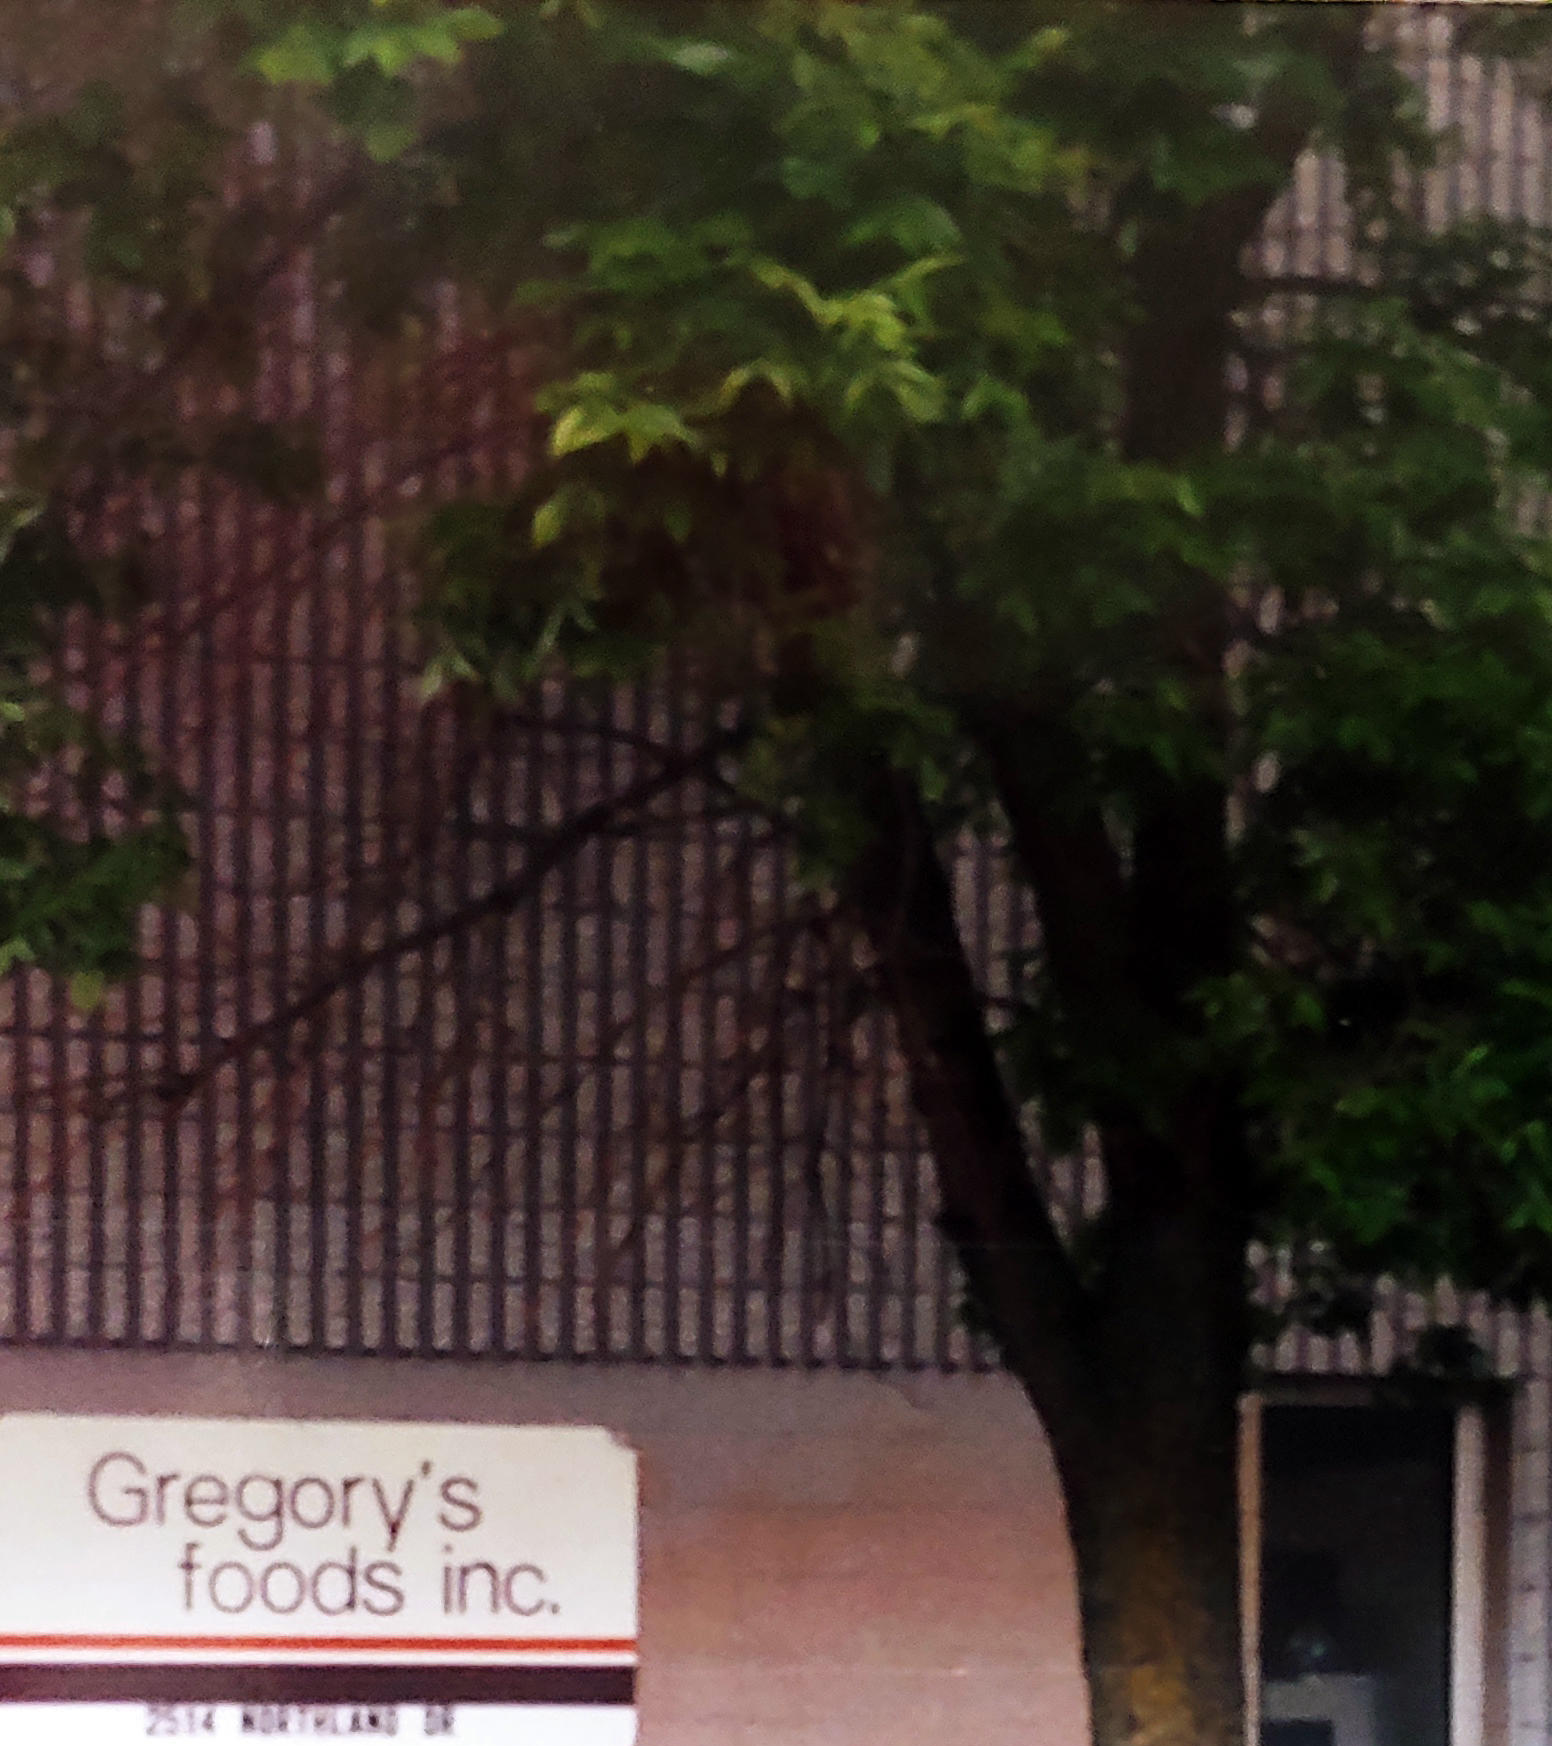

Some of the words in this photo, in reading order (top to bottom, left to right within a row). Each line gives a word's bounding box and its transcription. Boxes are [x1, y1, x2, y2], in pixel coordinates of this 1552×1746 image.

[86, 1450, 484, 1552] Gregory's
[178, 1541, 405, 1616] foods
[442, 1545, 561, 1617] inc.
